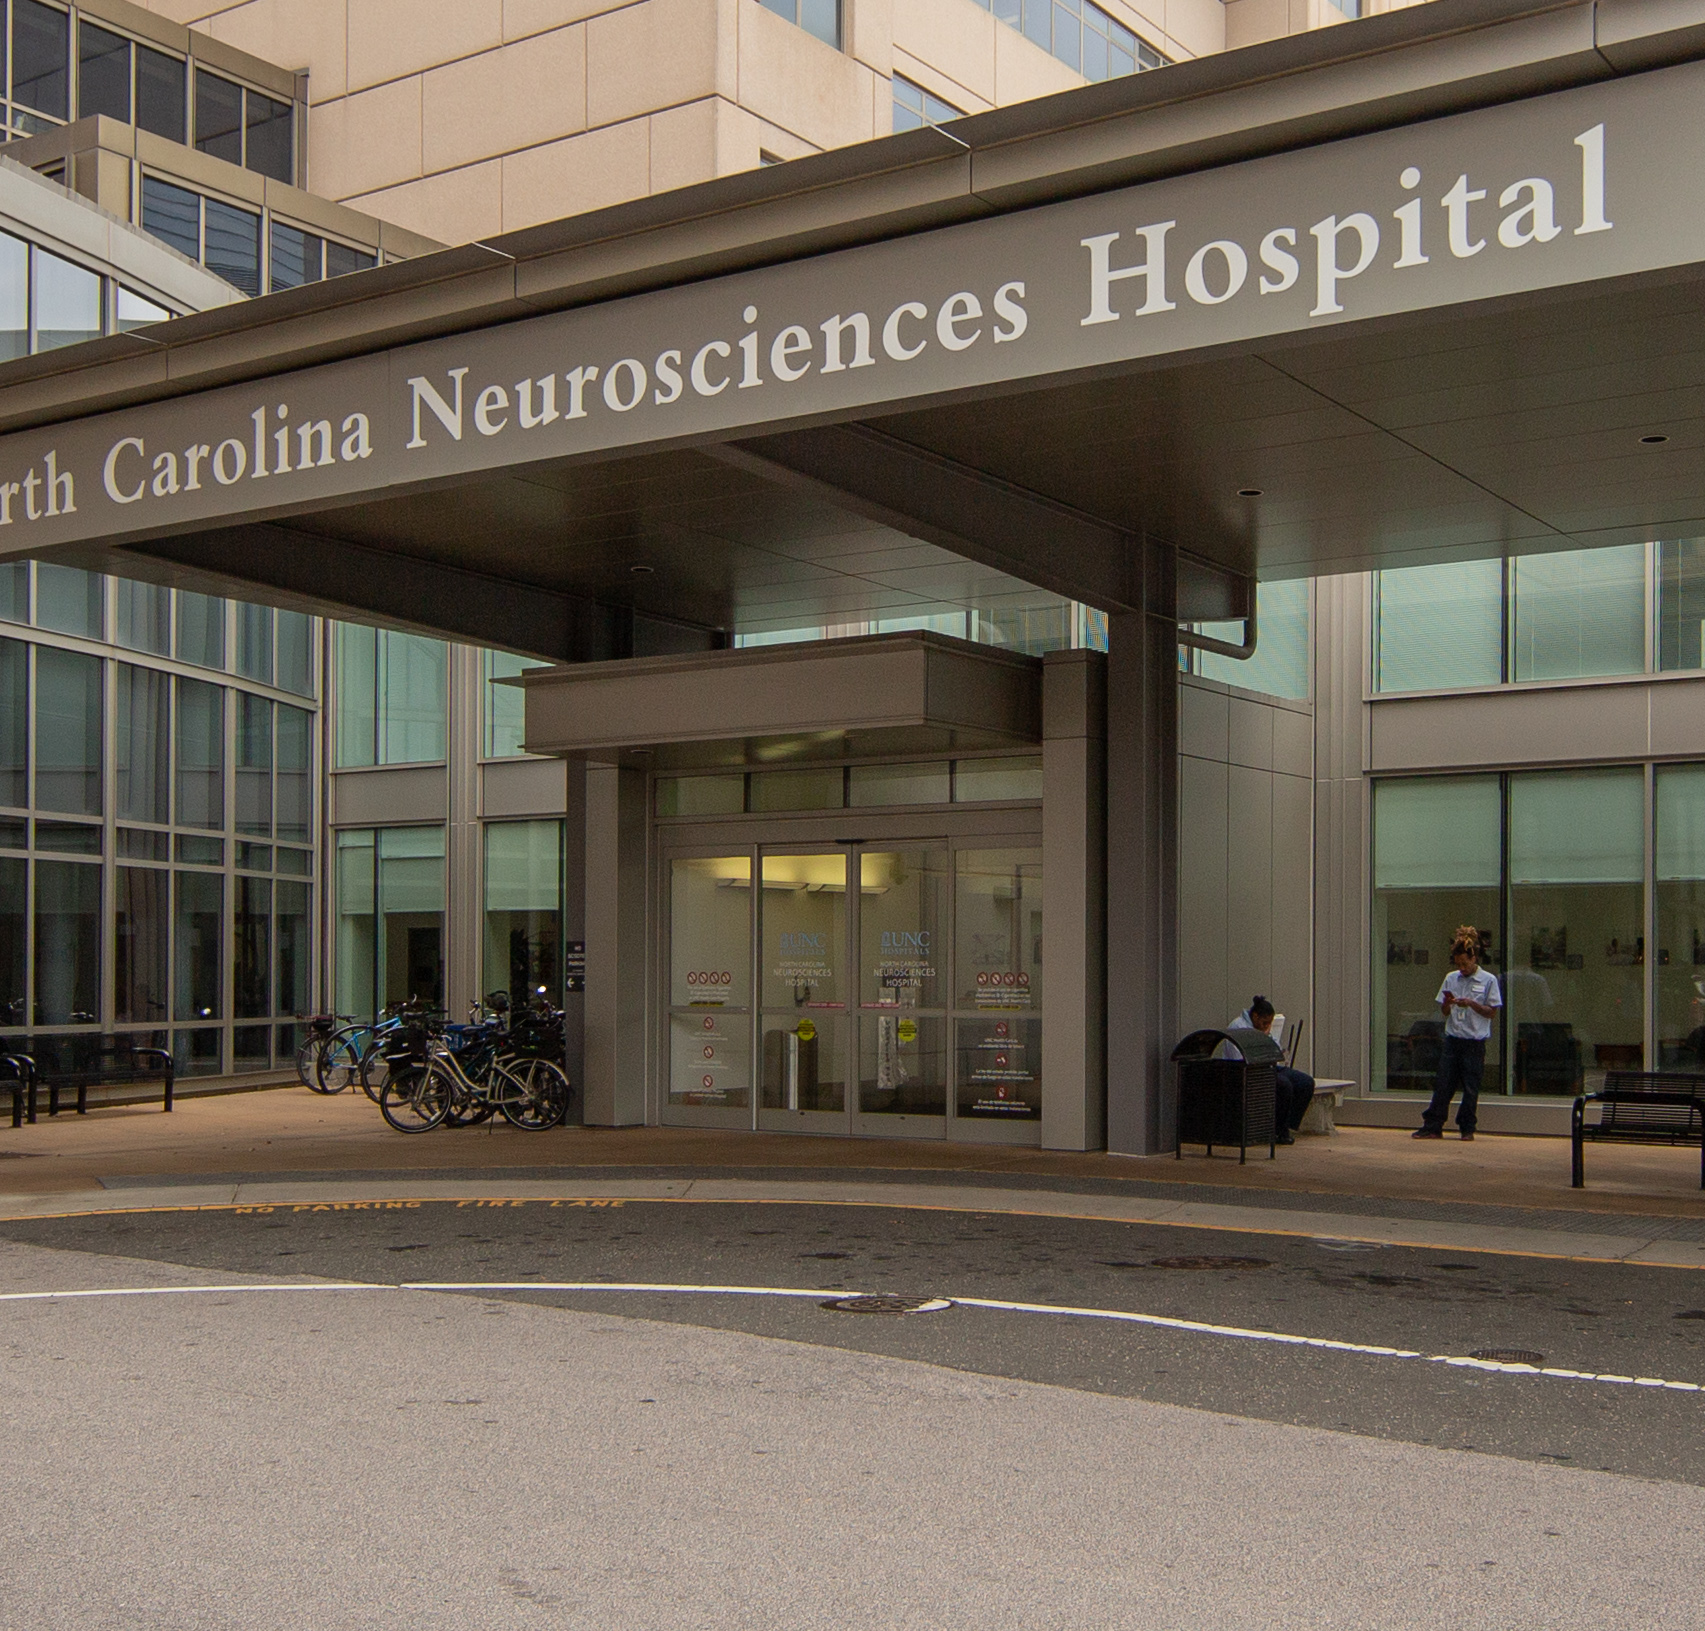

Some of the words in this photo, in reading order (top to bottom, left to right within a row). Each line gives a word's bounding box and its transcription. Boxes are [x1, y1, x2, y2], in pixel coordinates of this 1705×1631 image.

[102, 403, 374, 504] Carolina
[406, 281, 1028, 450] Neurosciences
[1080, 123, 1614, 317] Hospital
[790, 932, 826, 947] UNC
[892, 931, 930, 947] UNC
[880, 947, 930, 955] HOSPITALS
[773, 968, 832, 977] NEUROSCIENCES
[873, 968, 936, 977] NEUROSCIENCES
[785, 978, 819, 987] HOSPITAL
[886, 978, 923, 987] HOSPITAL
[235, 1206, 275, 1214] NO
[292, 1201, 421, 1213] PARKING
[456, 1199, 527, 1208] FIRE
[549, 1200, 626, 1208] LANE
